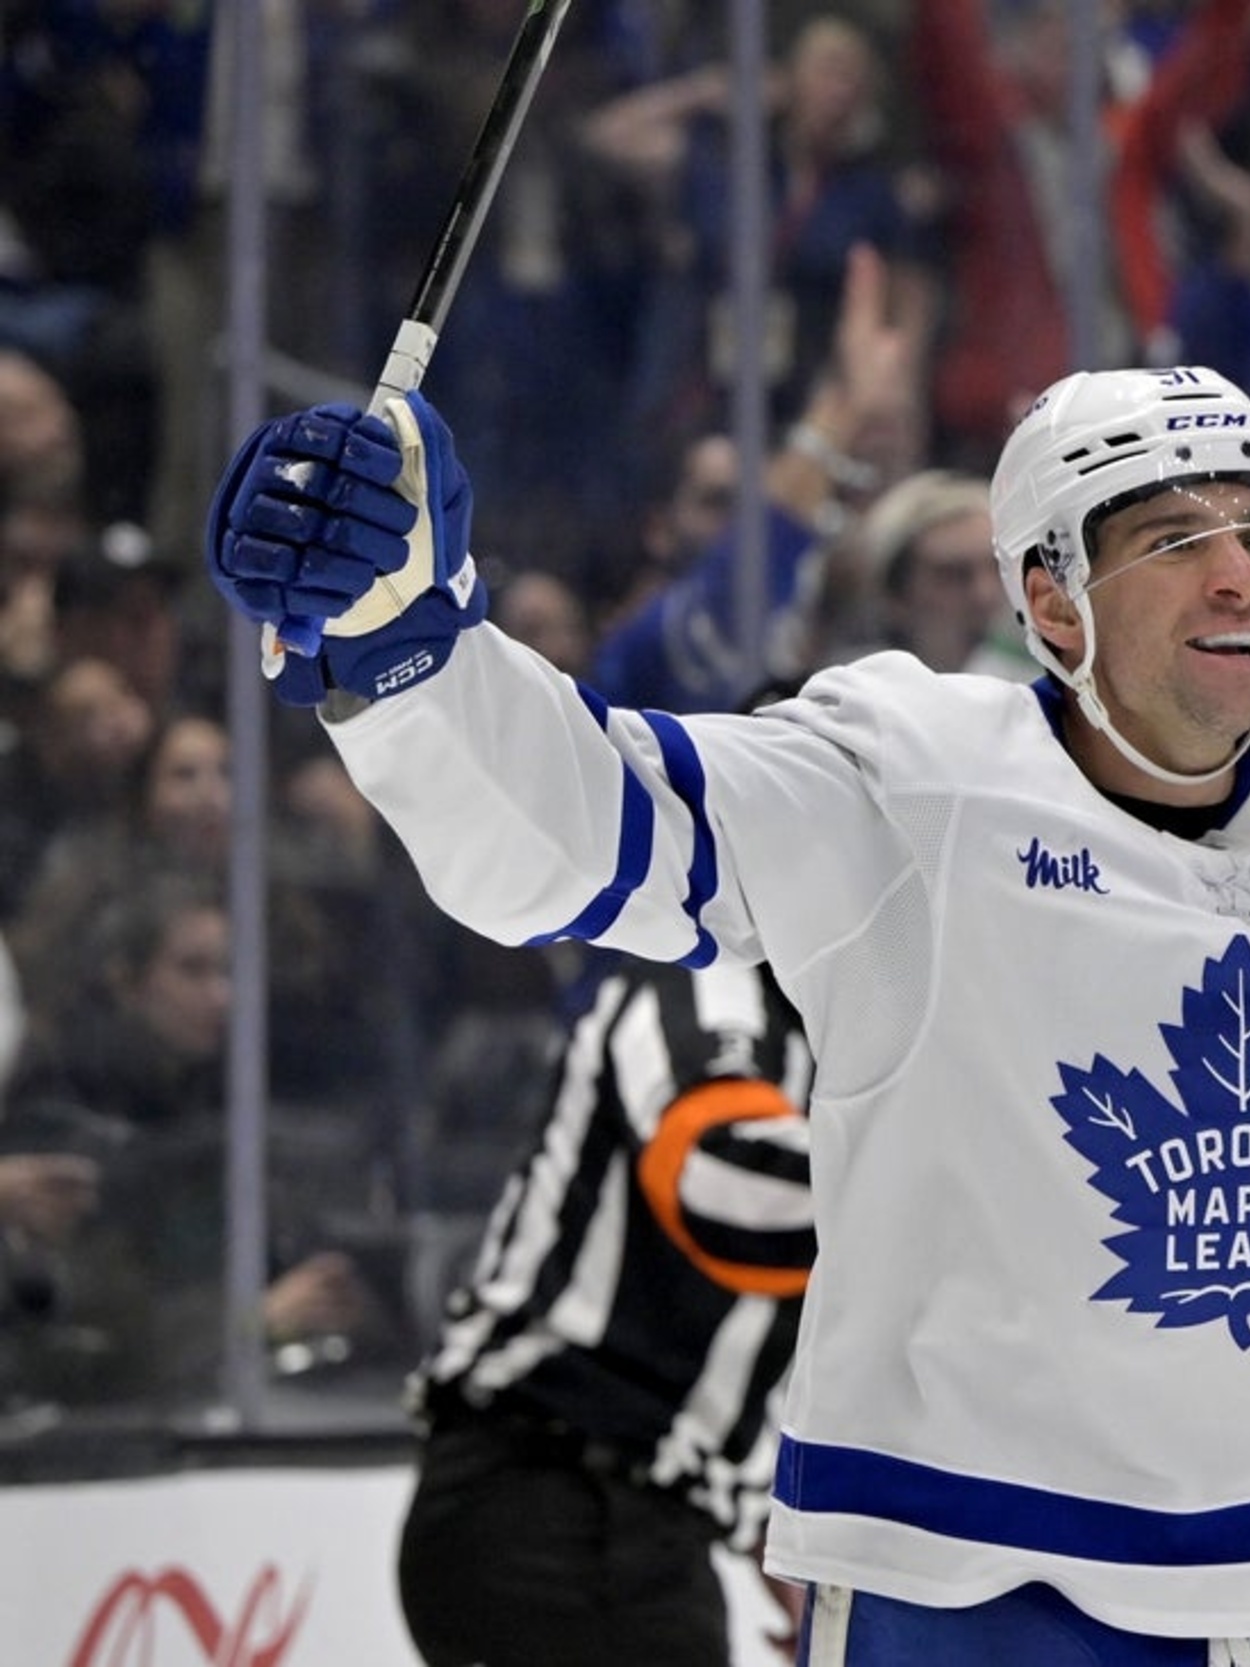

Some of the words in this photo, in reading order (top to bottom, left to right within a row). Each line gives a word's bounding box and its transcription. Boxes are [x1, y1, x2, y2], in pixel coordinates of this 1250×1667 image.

[1166, 413, 1247, 431] CCM
[376, 654, 433, 695] CCM
[1016, 836, 1111, 895] Milk
